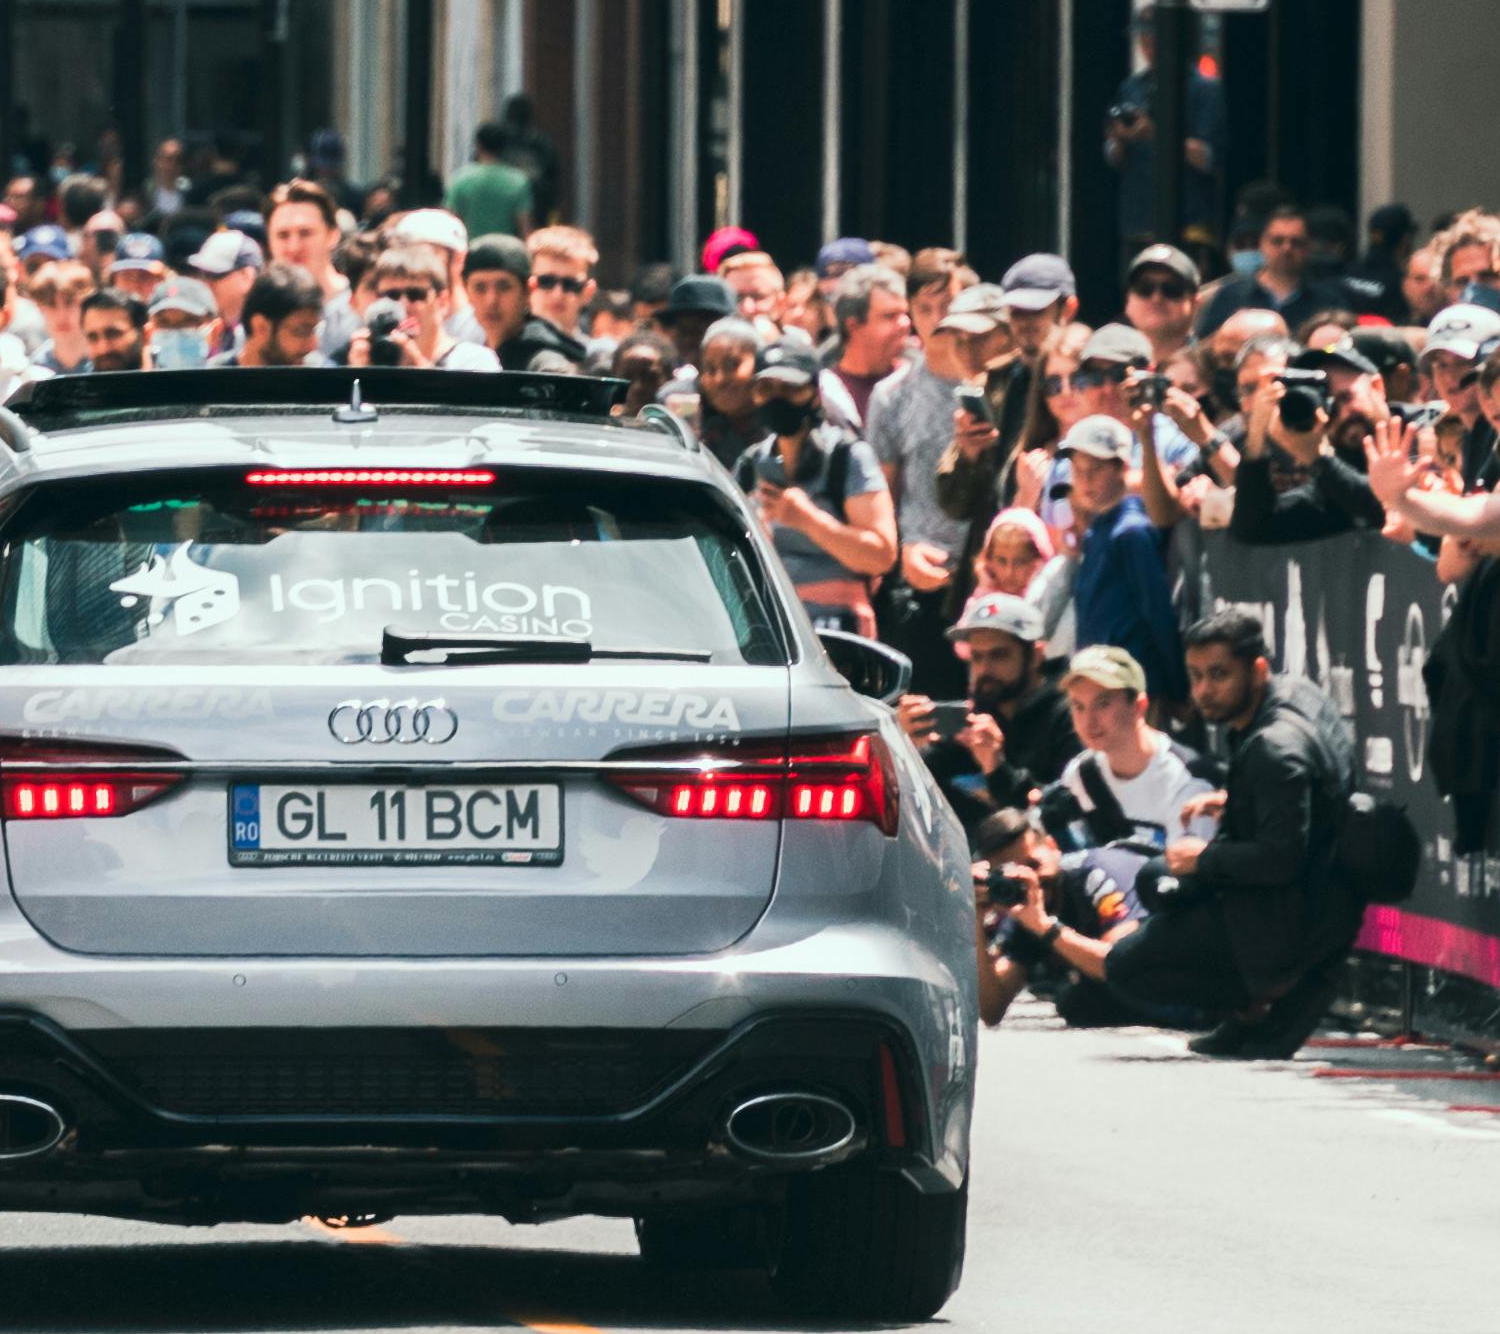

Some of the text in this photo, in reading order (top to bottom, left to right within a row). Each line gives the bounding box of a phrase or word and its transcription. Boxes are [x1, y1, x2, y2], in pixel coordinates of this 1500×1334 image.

[270, 569, 592, 624] Ignition
[439, 612, 594, 638] CASINO
[23, 688, 275, 722] CARRERA
[493, 689, 742, 731] CARRERA
[613, 728, 678, 741] SINCE
[235, 822, 258, 841] RO
[276, 789, 540, 841] GL 11 BCM
